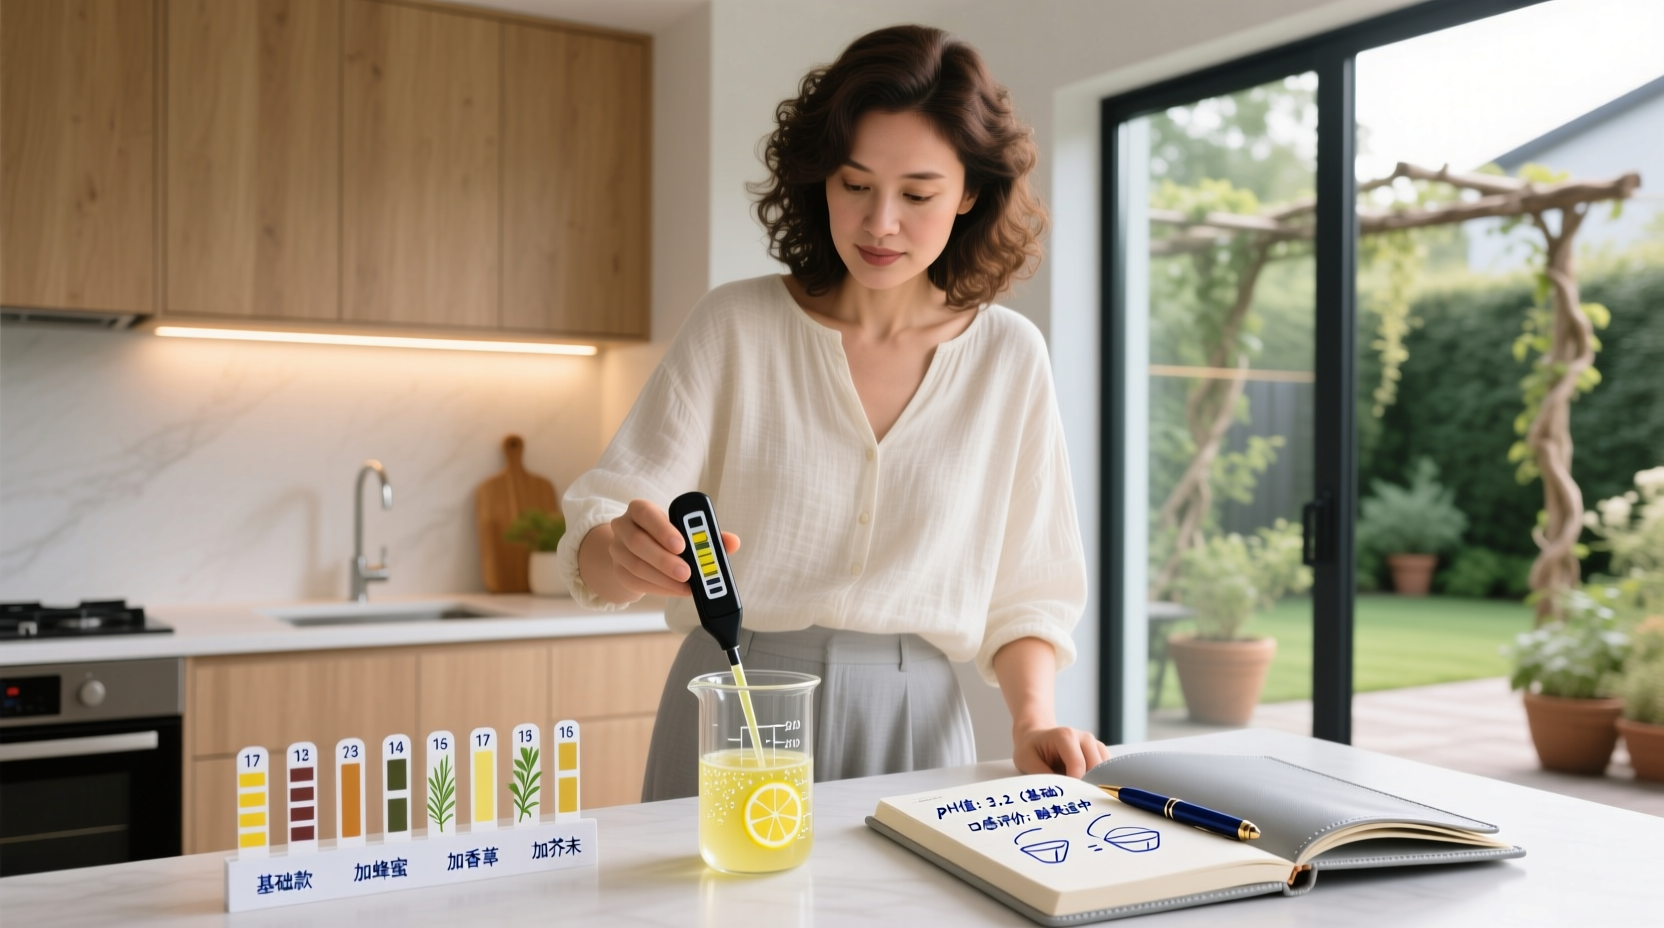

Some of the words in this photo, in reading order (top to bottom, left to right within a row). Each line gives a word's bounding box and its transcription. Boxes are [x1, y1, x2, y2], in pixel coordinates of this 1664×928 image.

[389, 740, 404, 755] 14
[476, 733, 491, 747] 17
[245, 754, 261, 768] 17
[986, 794, 1014, 808] 3.2
[531, 835, 582, 860] 加芥末
[353, 857, 408, 882] 加蜂蜜
[256, 869, 313, 895] 基础款
